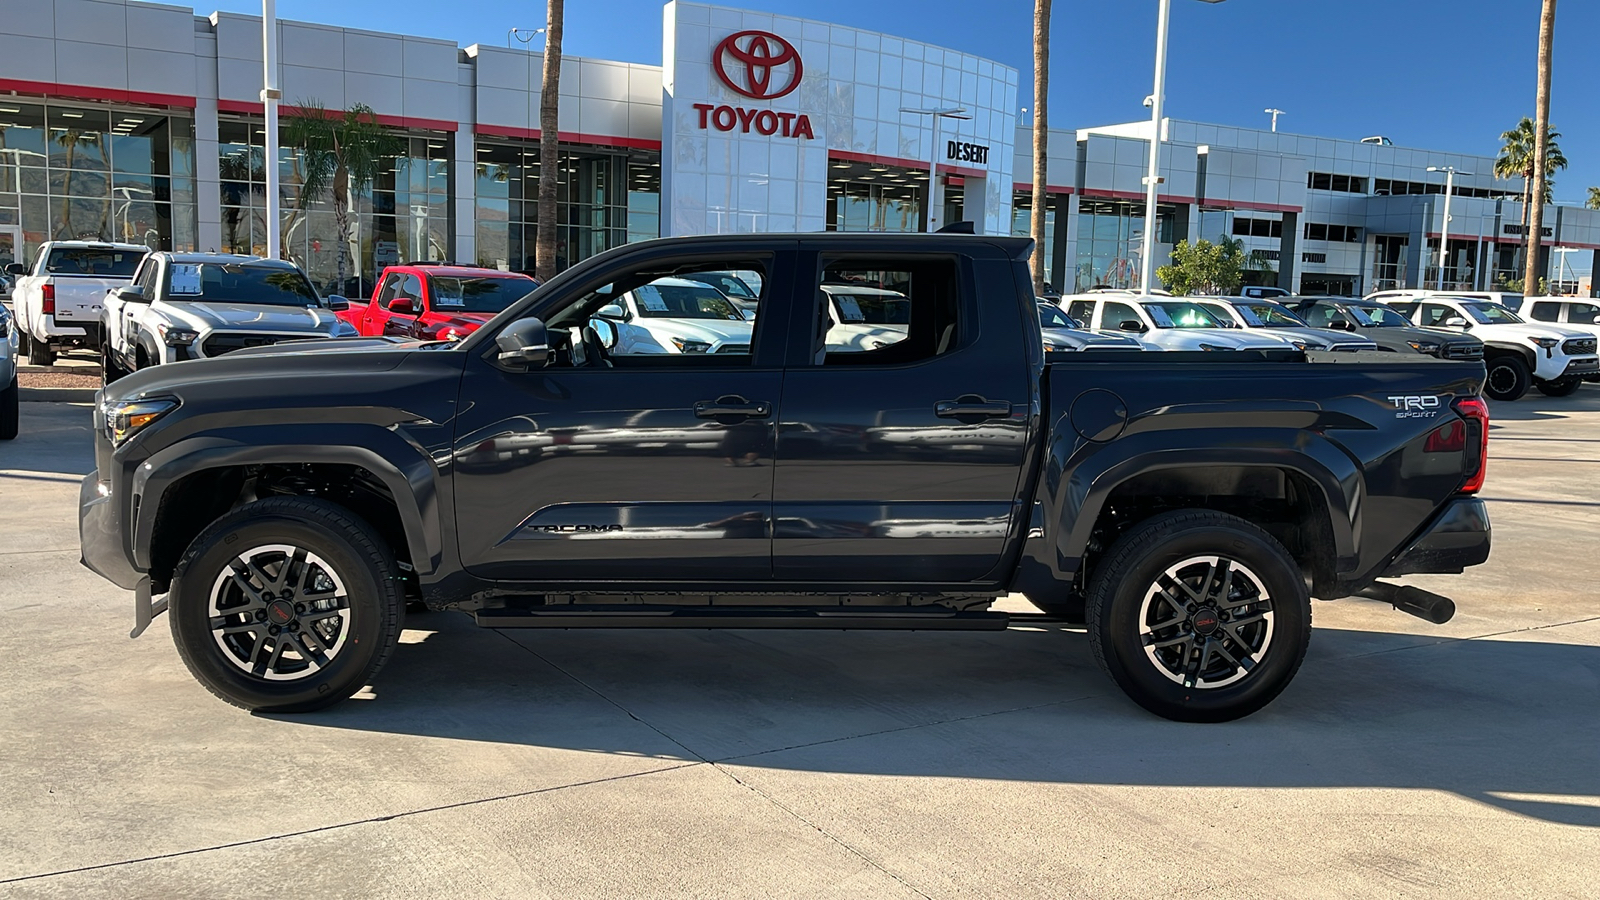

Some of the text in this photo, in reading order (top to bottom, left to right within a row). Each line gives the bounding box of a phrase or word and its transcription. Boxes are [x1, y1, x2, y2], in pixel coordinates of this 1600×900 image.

[693, 103, 814, 139] TOYOTA
[947, 140, 989, 164] DESERT
[1387, 395, 1440, 411] TRD
[527, 524, 623, 533] TACOMA
